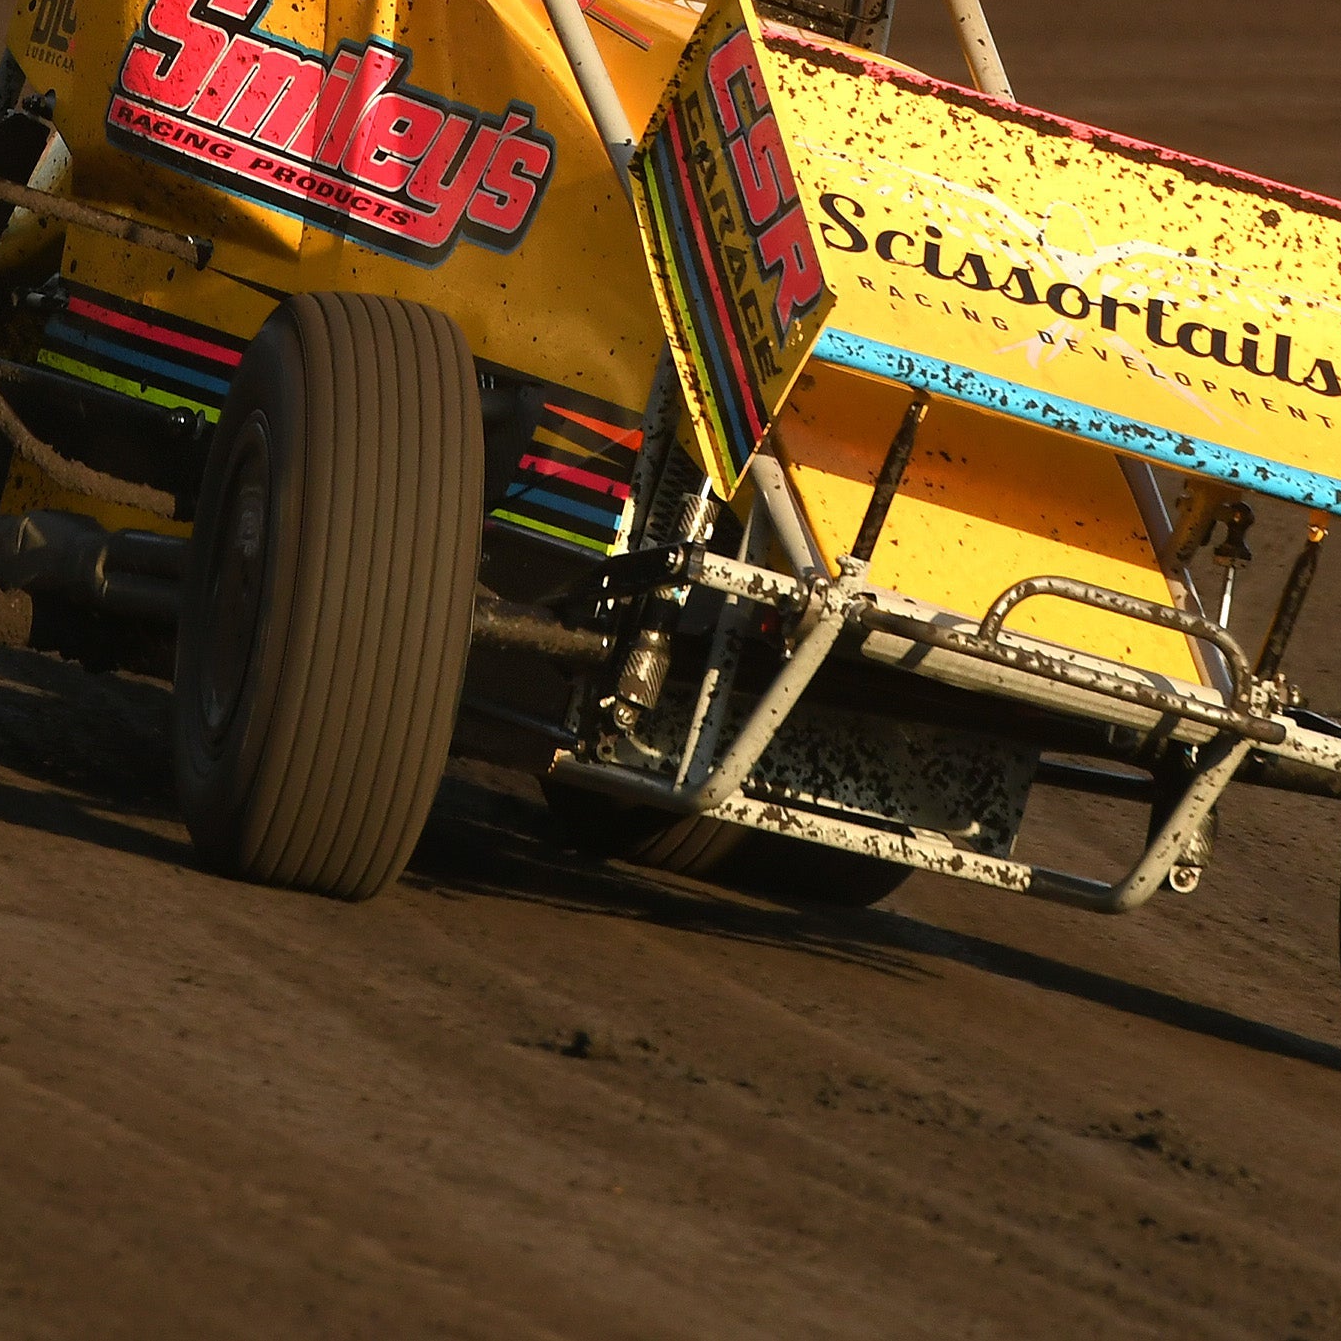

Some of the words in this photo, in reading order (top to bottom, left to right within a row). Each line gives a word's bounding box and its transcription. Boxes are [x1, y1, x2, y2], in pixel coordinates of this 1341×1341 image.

[116, 105, 237, 161] RACING
[247, 157, 412, 227] PRODUCTS
[681, 90, 783, 383] GARAGE
[858, 275, 1009, 332] RACING
[1038, 328, 1331, 429] DEVELOPMENT
